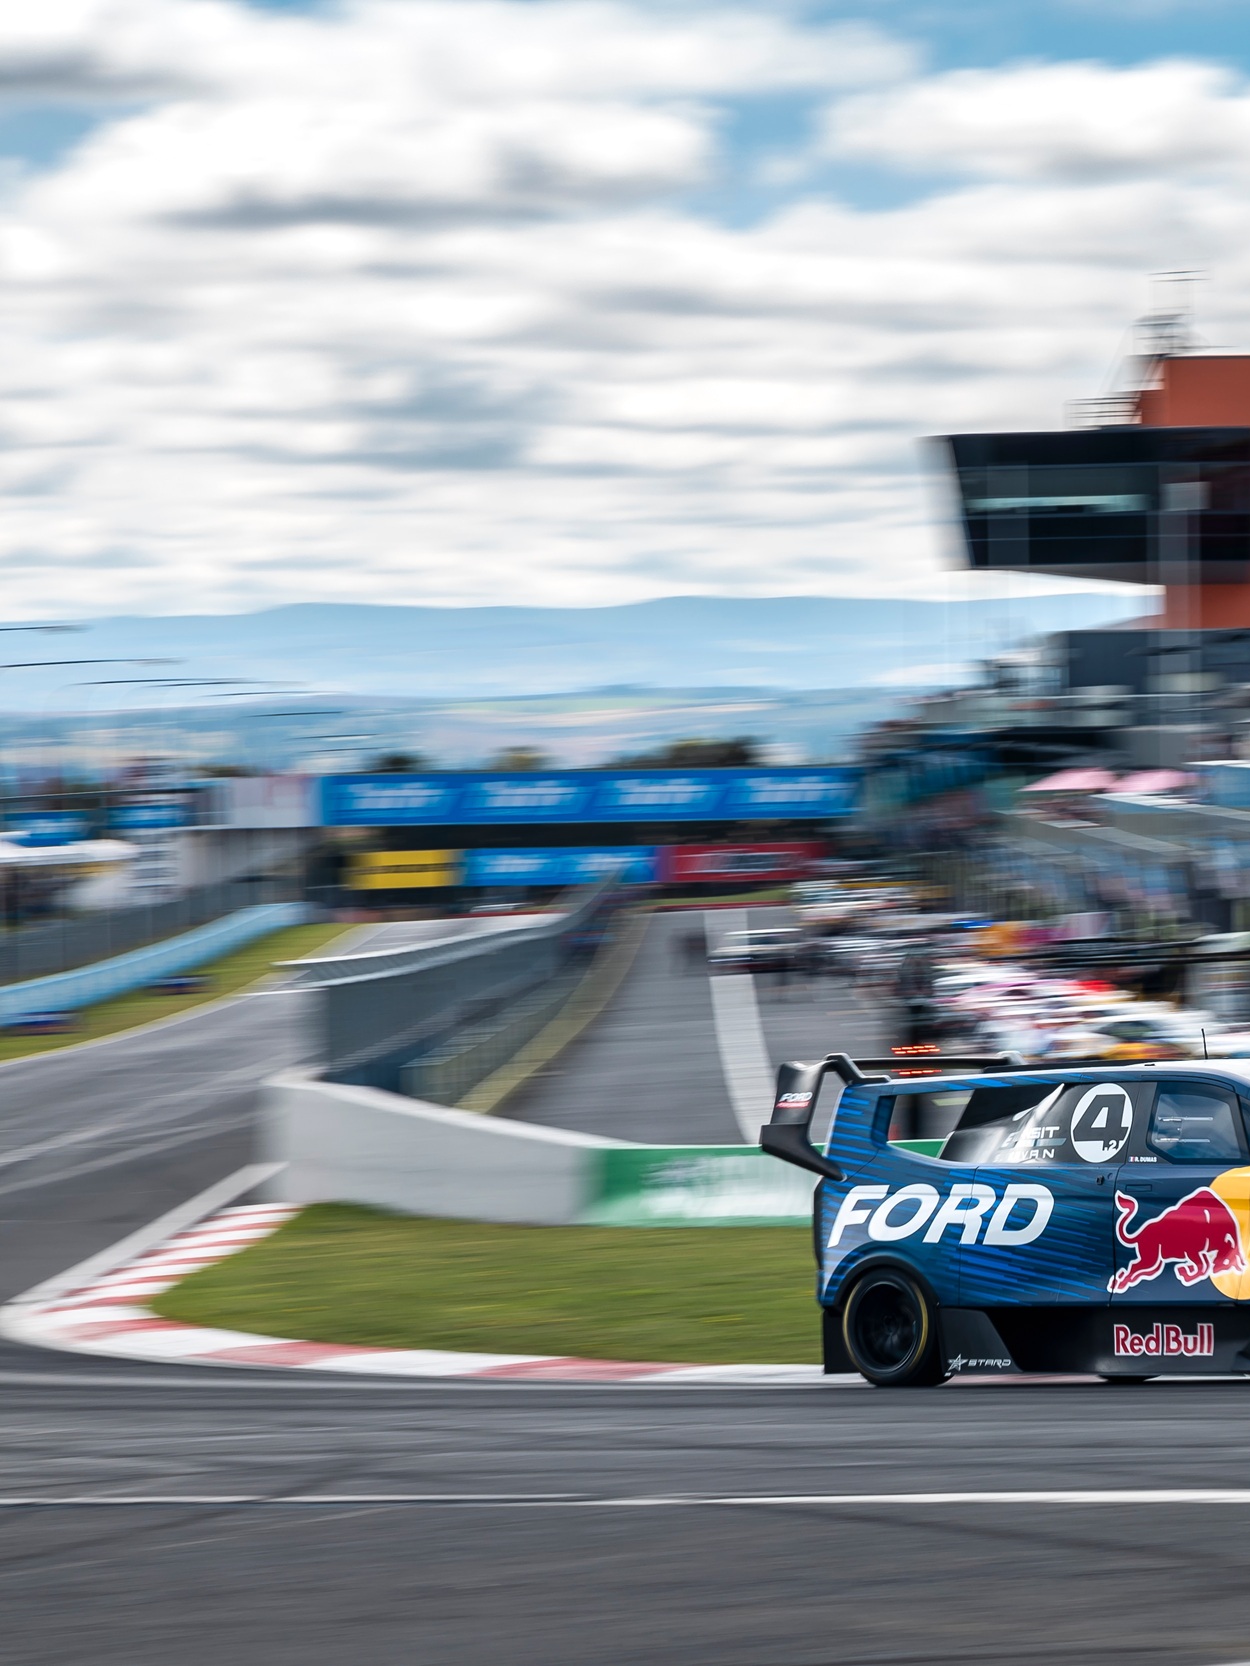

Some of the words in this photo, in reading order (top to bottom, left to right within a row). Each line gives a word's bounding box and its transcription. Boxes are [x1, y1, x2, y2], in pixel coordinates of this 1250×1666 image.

[779, 1092, 813, 1102] FORD
[827, 1183, 1055, 1248] FORD
[1113, 1323, 1162, 1356] Red
[1163, 1323, 1214, 1357] Bull
[967, 1358, 1012, 1369] STARD
